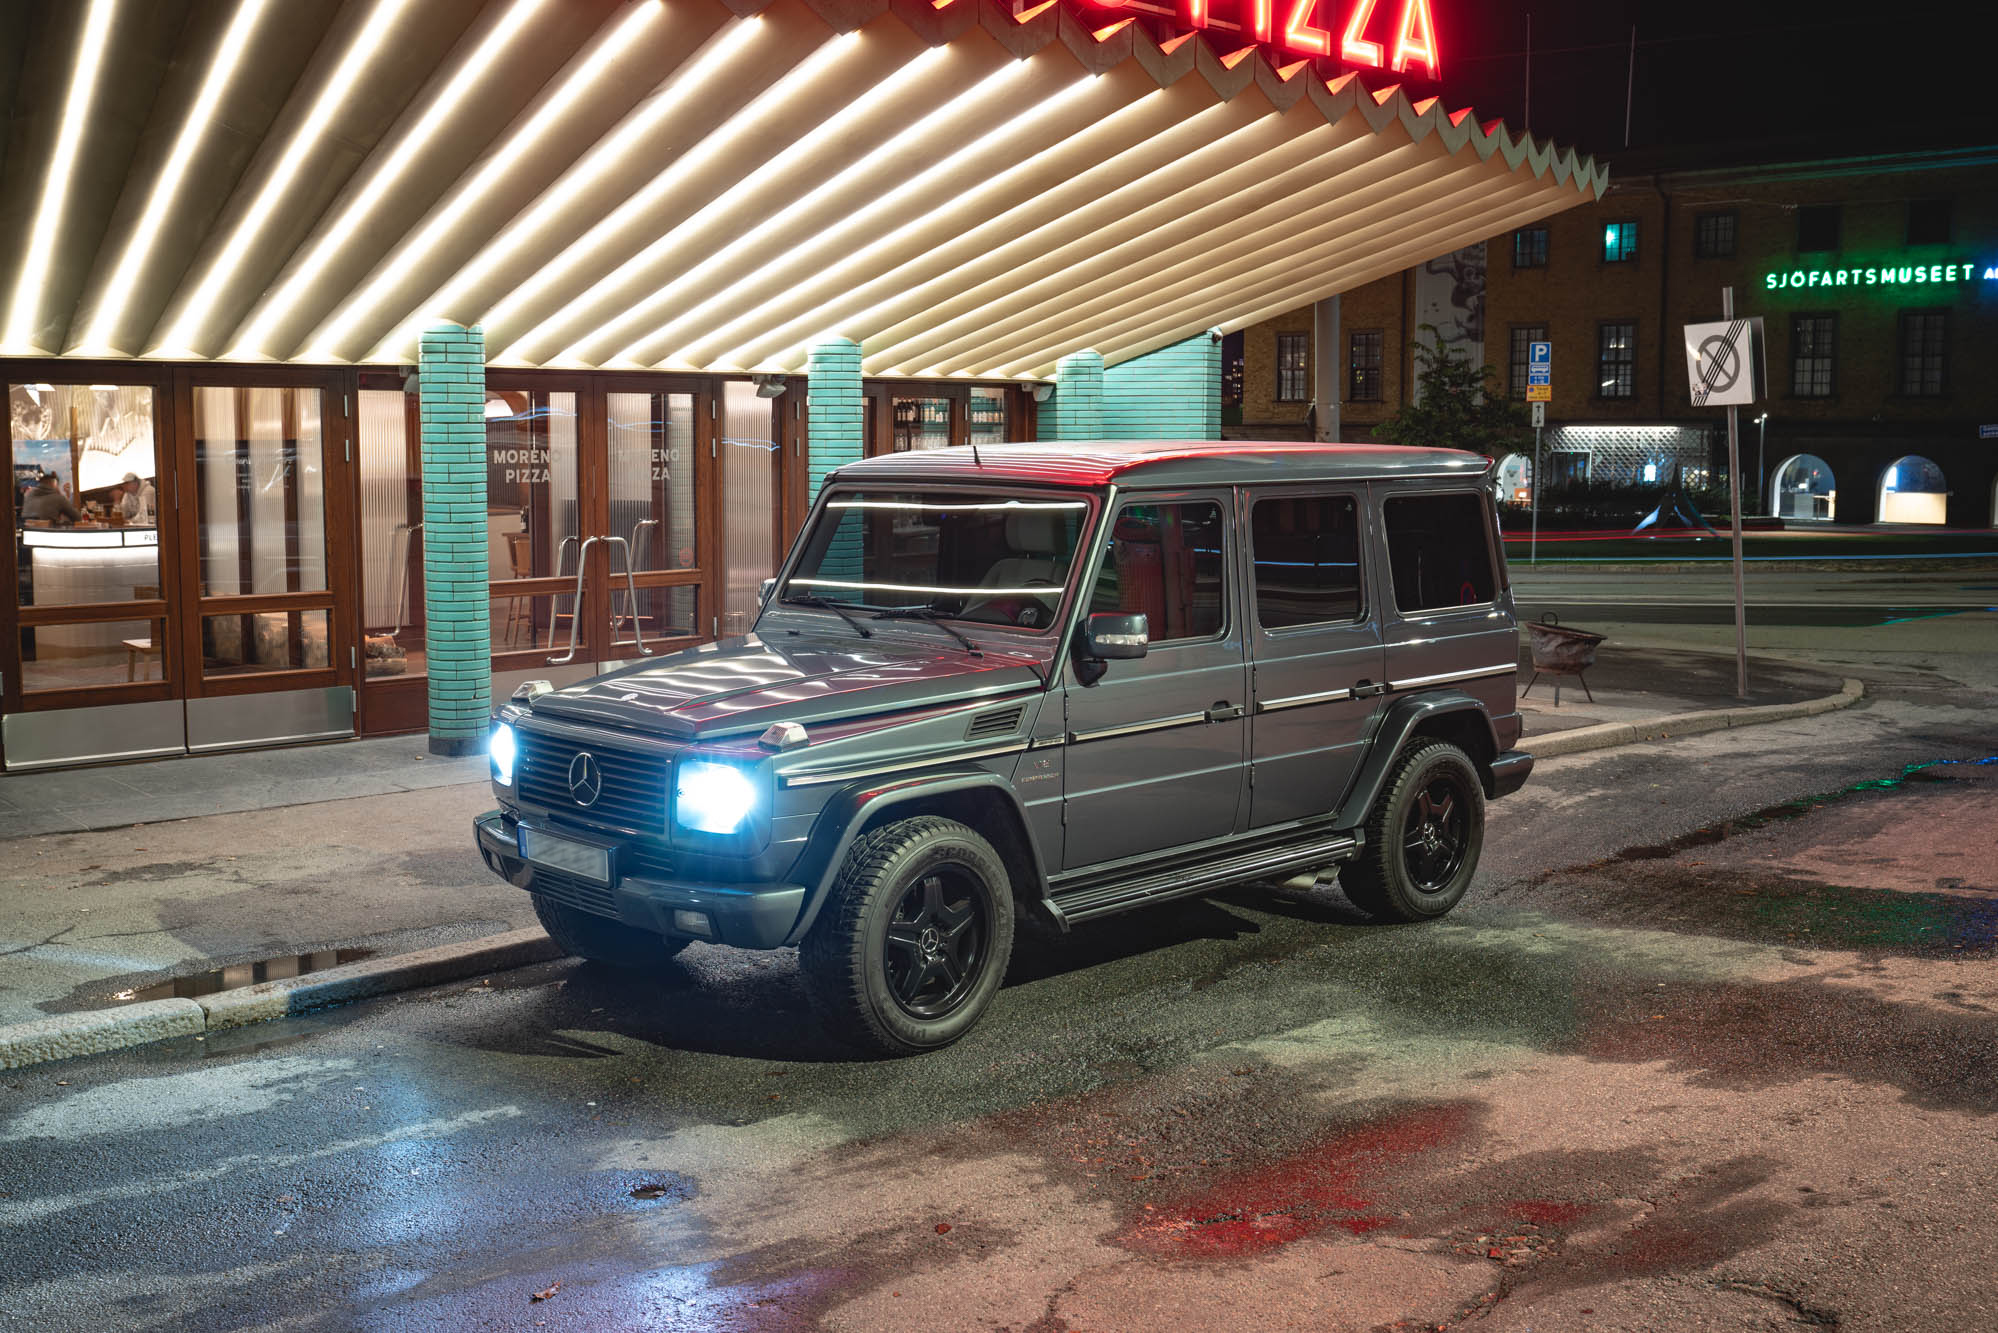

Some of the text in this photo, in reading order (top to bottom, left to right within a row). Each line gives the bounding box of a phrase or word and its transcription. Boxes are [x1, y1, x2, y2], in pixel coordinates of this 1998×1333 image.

[1190, 0, 1442, 81] ZZA
[1766, 264, 1975, 289] SJÖFARTSMUSEET
[1535, 345, 1547, 361] P
[505, 469, 551, 483] PIZZA
